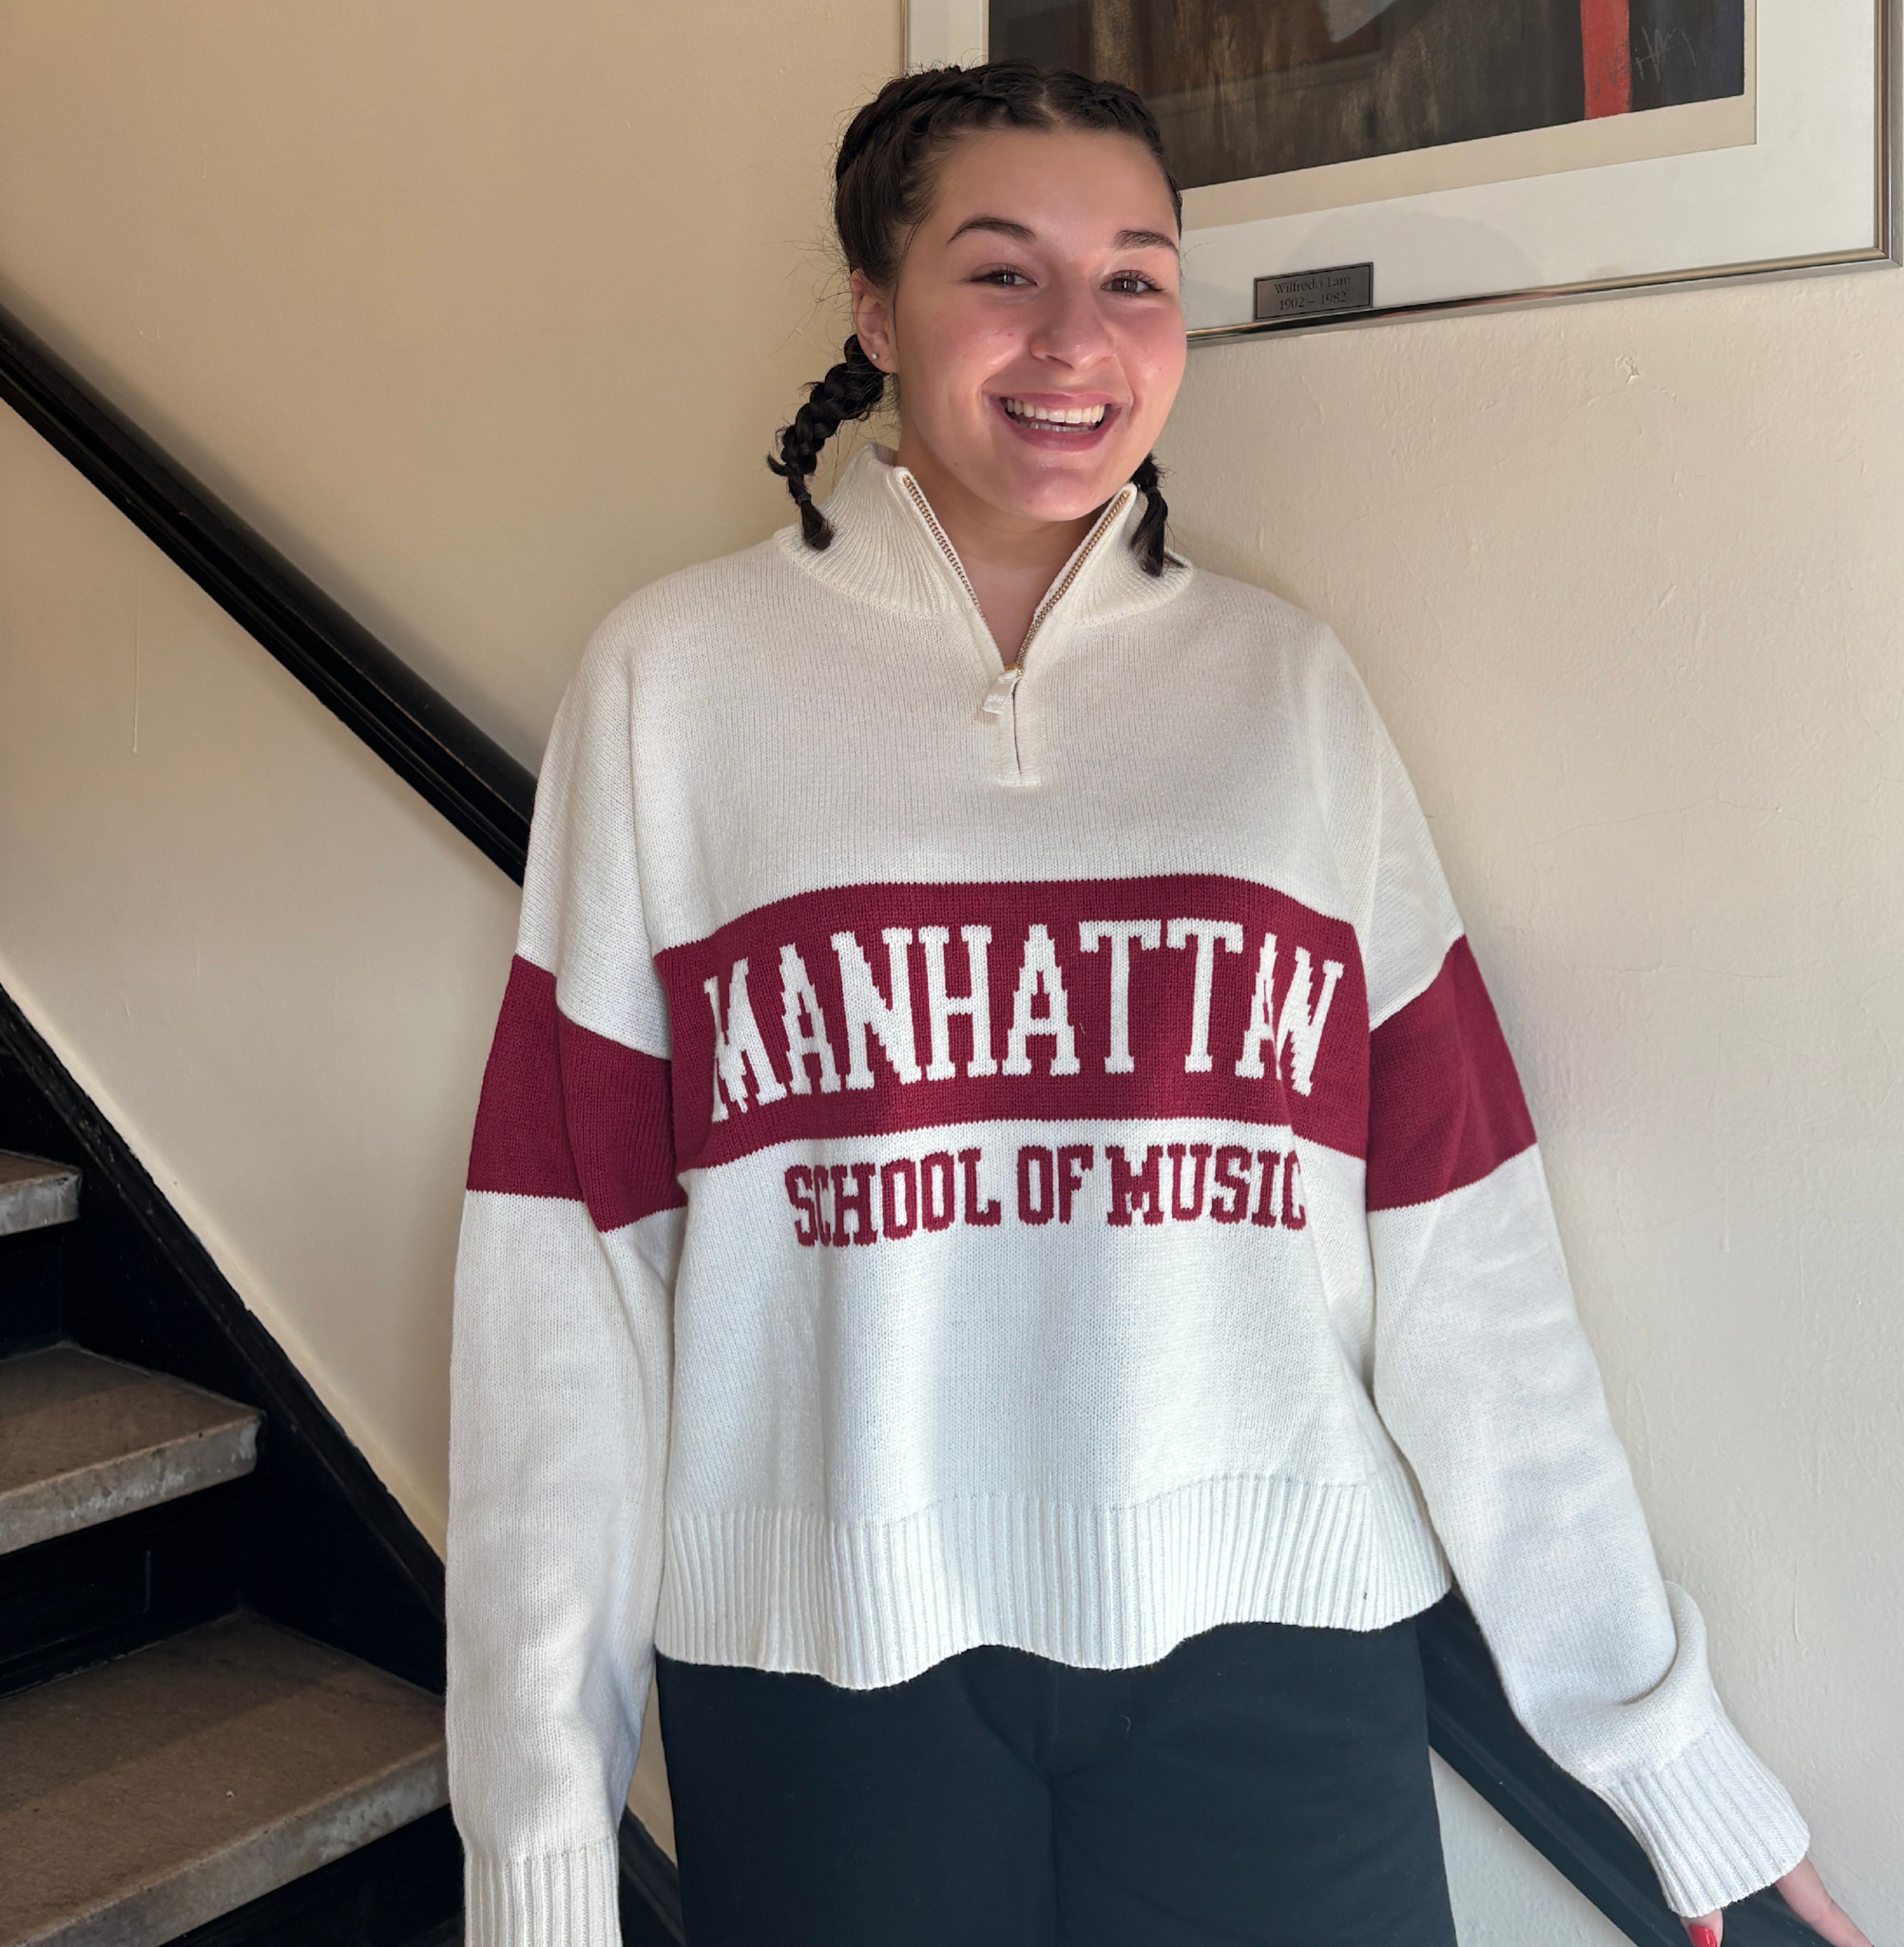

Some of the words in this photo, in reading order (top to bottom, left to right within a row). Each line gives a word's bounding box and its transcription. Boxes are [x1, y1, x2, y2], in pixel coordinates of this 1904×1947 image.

[1274, 278, 1323, 295] Wilfredo
[1326, 276, 1351, 288] Lam
[1279, 296, 1305, 311] 1902
[1320, 291, 1347, 305] 1982
[702, 917, 1344, 1124] MANHATTAN
[784, 1145, 1002, 1248] SCHOOL
[1017, 1143, 1094, 1227] OF
[1105, 1143, 1307, 1231] MUSIC
